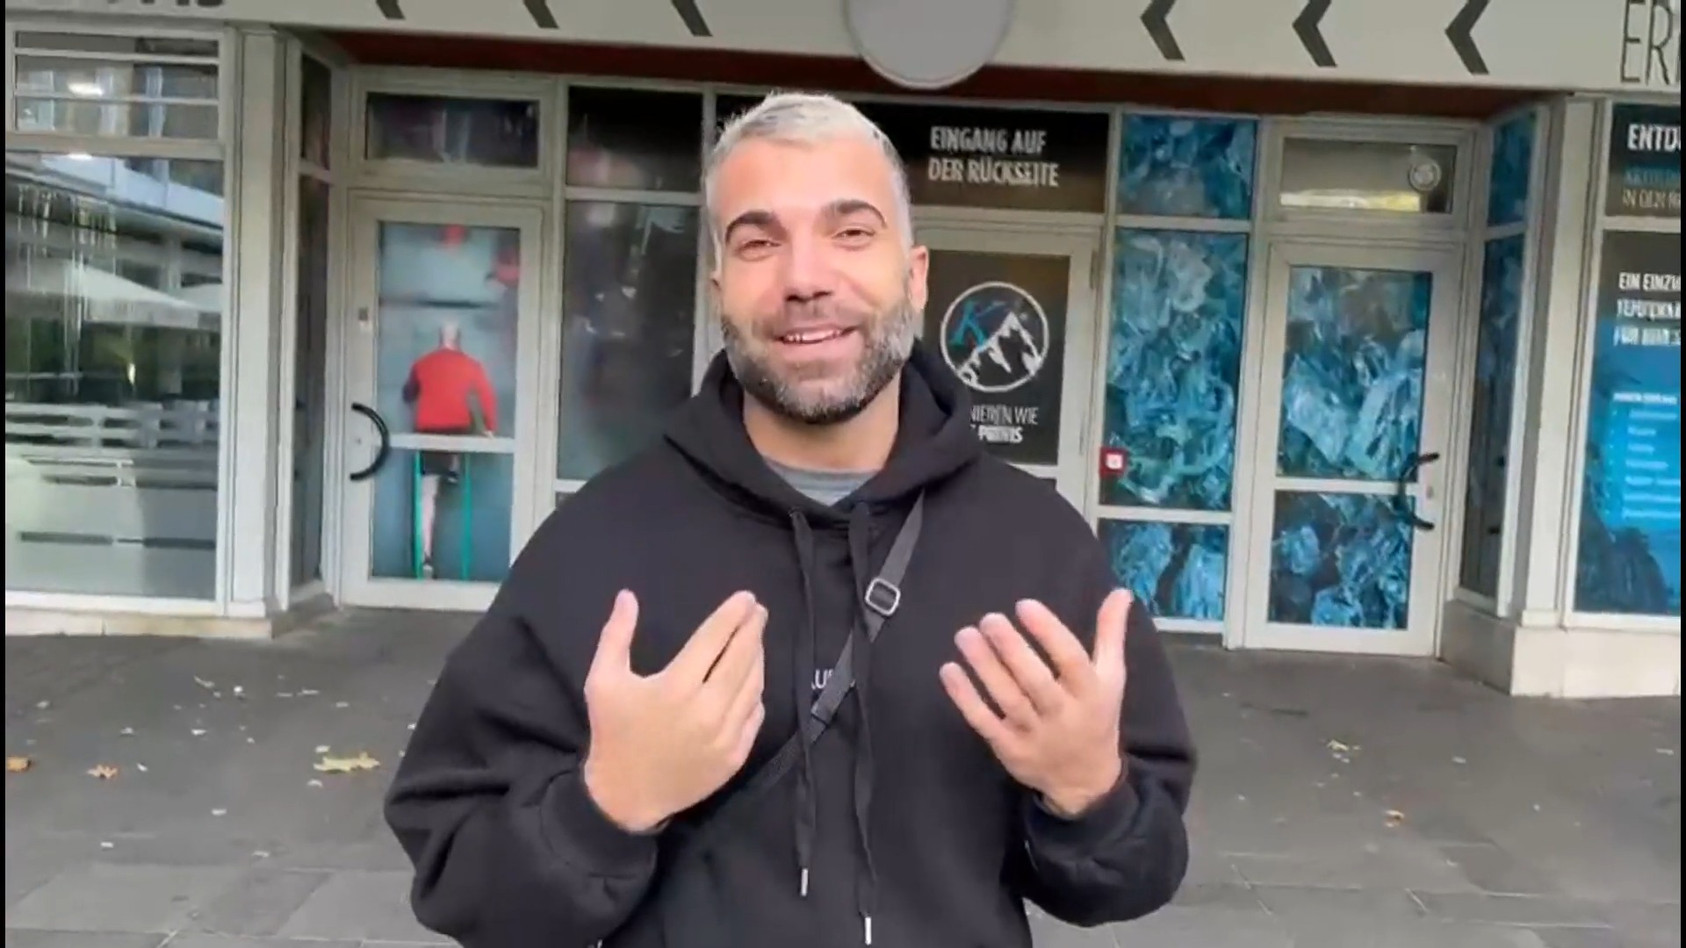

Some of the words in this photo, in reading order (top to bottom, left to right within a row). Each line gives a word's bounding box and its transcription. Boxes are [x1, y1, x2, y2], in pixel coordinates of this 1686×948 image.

[1620, 0, 1681, 85] ER
[930, 126, 1007, 153] EINGANG
[1011, 129, 1047, 154] AUF
[1627, 124, 1681, 151] ENTD
[928, 157, 963, 182] DER
[967, 156, 1060, 187] RÜCKSEITE
[1014, 406, 1039, 425] WIE
